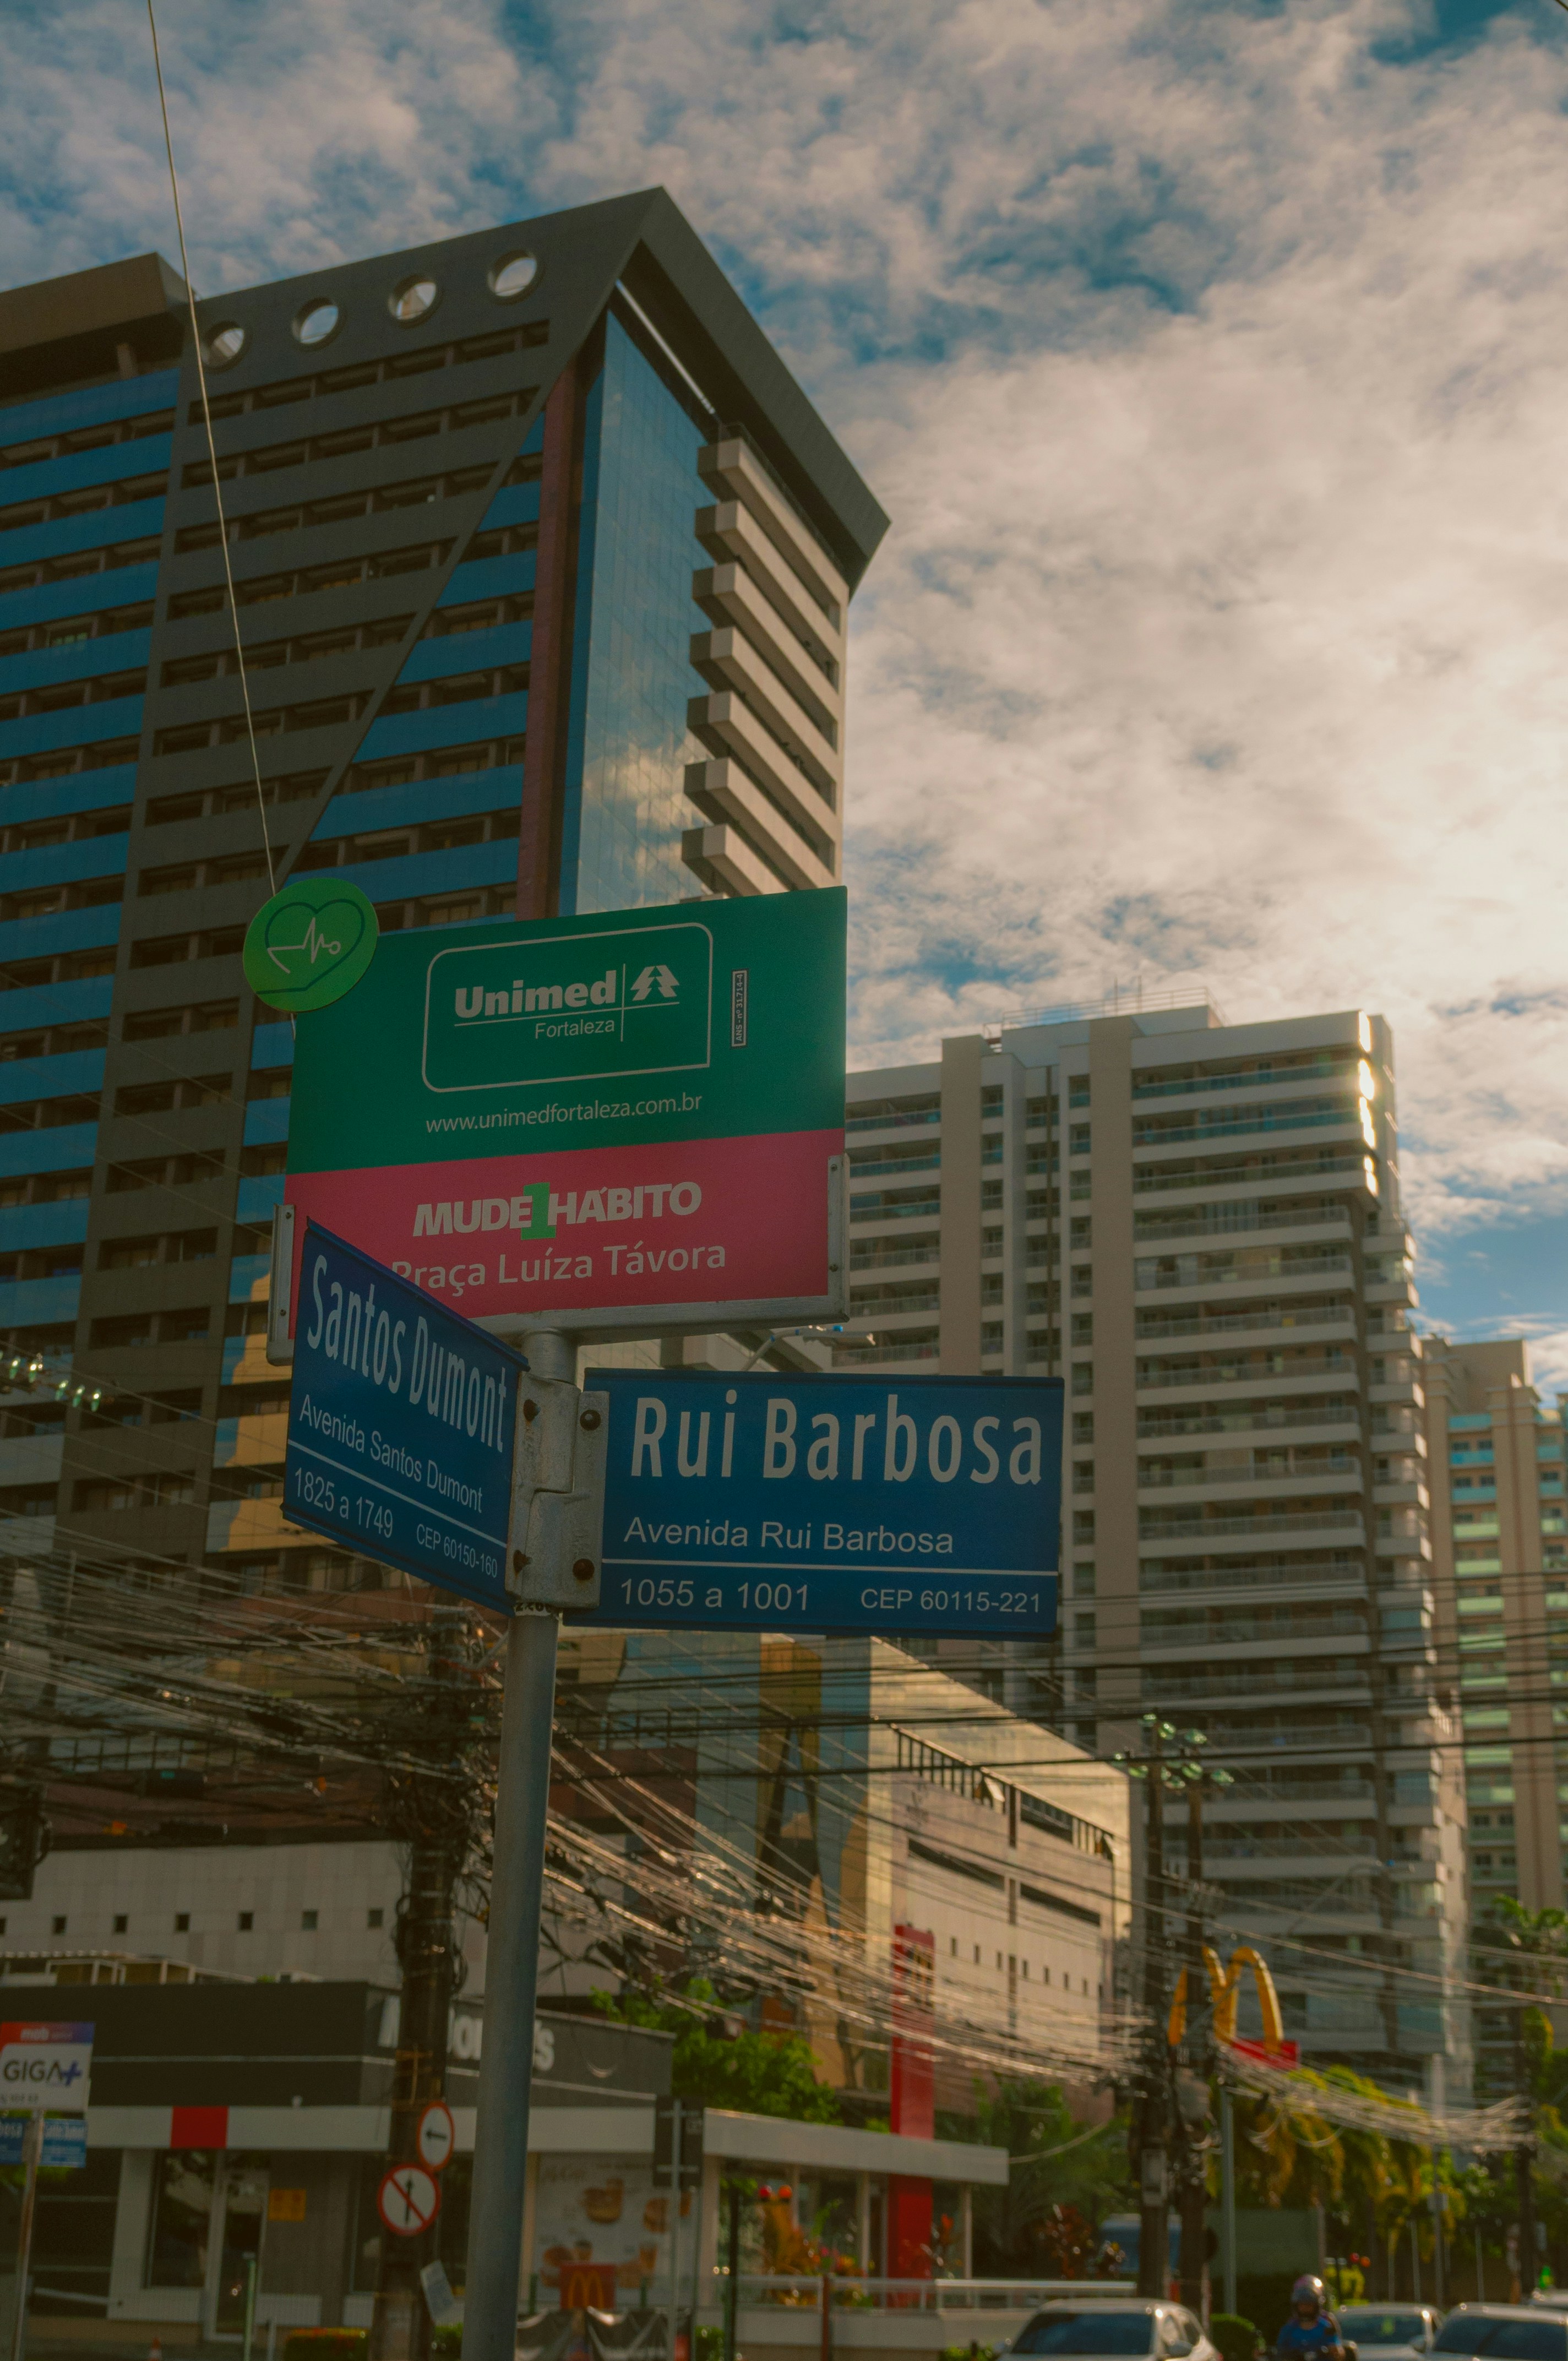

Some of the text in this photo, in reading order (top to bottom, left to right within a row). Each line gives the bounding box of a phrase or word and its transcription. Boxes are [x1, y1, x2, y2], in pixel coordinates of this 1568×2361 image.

[455, 970, 617, 1019] Unimed
[535, 1019, 615, 1040] Fortaleza
[426, 1092, 703, 1133] www.unimedfortaleza.com.br
[499, 1247, 592, 1283] Luíza
[603, 1240, 726, 1276] Távora
[307, 1255, 507, 1453] Santos Dumont
[299, 1394, 482, 1514] Avenida Santos Dumont
[630, 1389, 1042, 1485] Rui Barbosa
[295, 1467, 393, 1538] 1825 a 1749
[416, 1524, 498, 1578] CEP 60150-160
[624, 1516, 954, 1554] Avenida Rui Barbosa
[620, 1579, 809, 1611] 1055 a 1001
[861, 1588, 1039, 1613] CEP 60115-221
